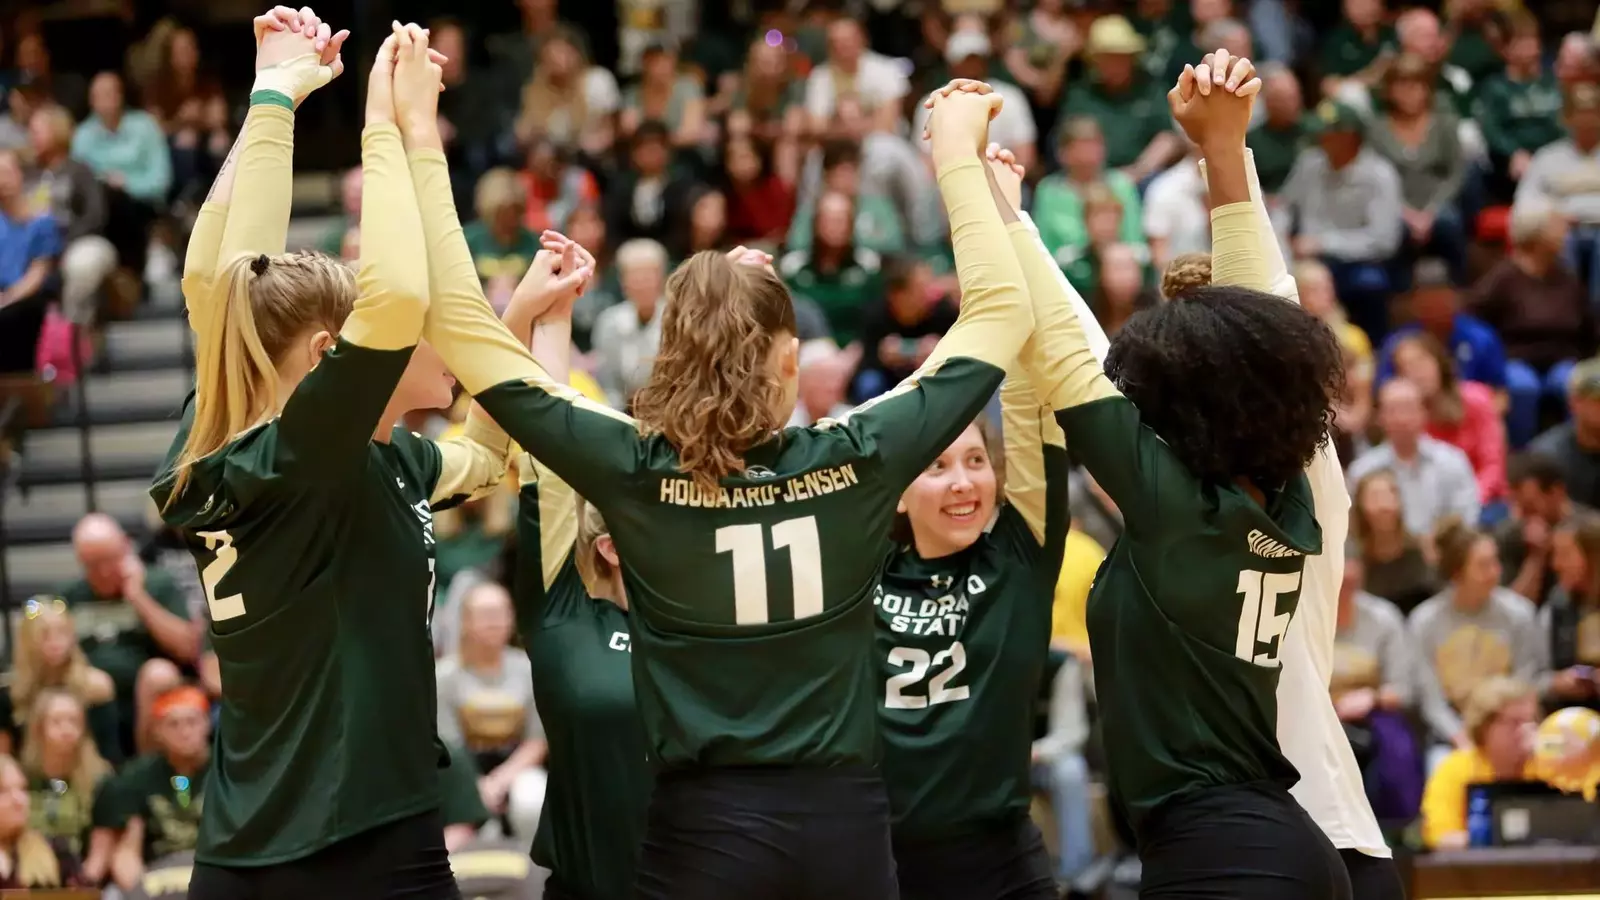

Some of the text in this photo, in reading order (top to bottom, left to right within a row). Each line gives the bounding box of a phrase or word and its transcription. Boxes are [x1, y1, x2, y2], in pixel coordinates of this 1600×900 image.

[196, 529, 246, 621] 2
[715, 515, 824, 625] 11
[873, 574, 987, 618] COLORAO
[890, 613, 967, 636] STAT
[1235, 569, 1301, 668] 15
[885, 641, 970, 709] 22
